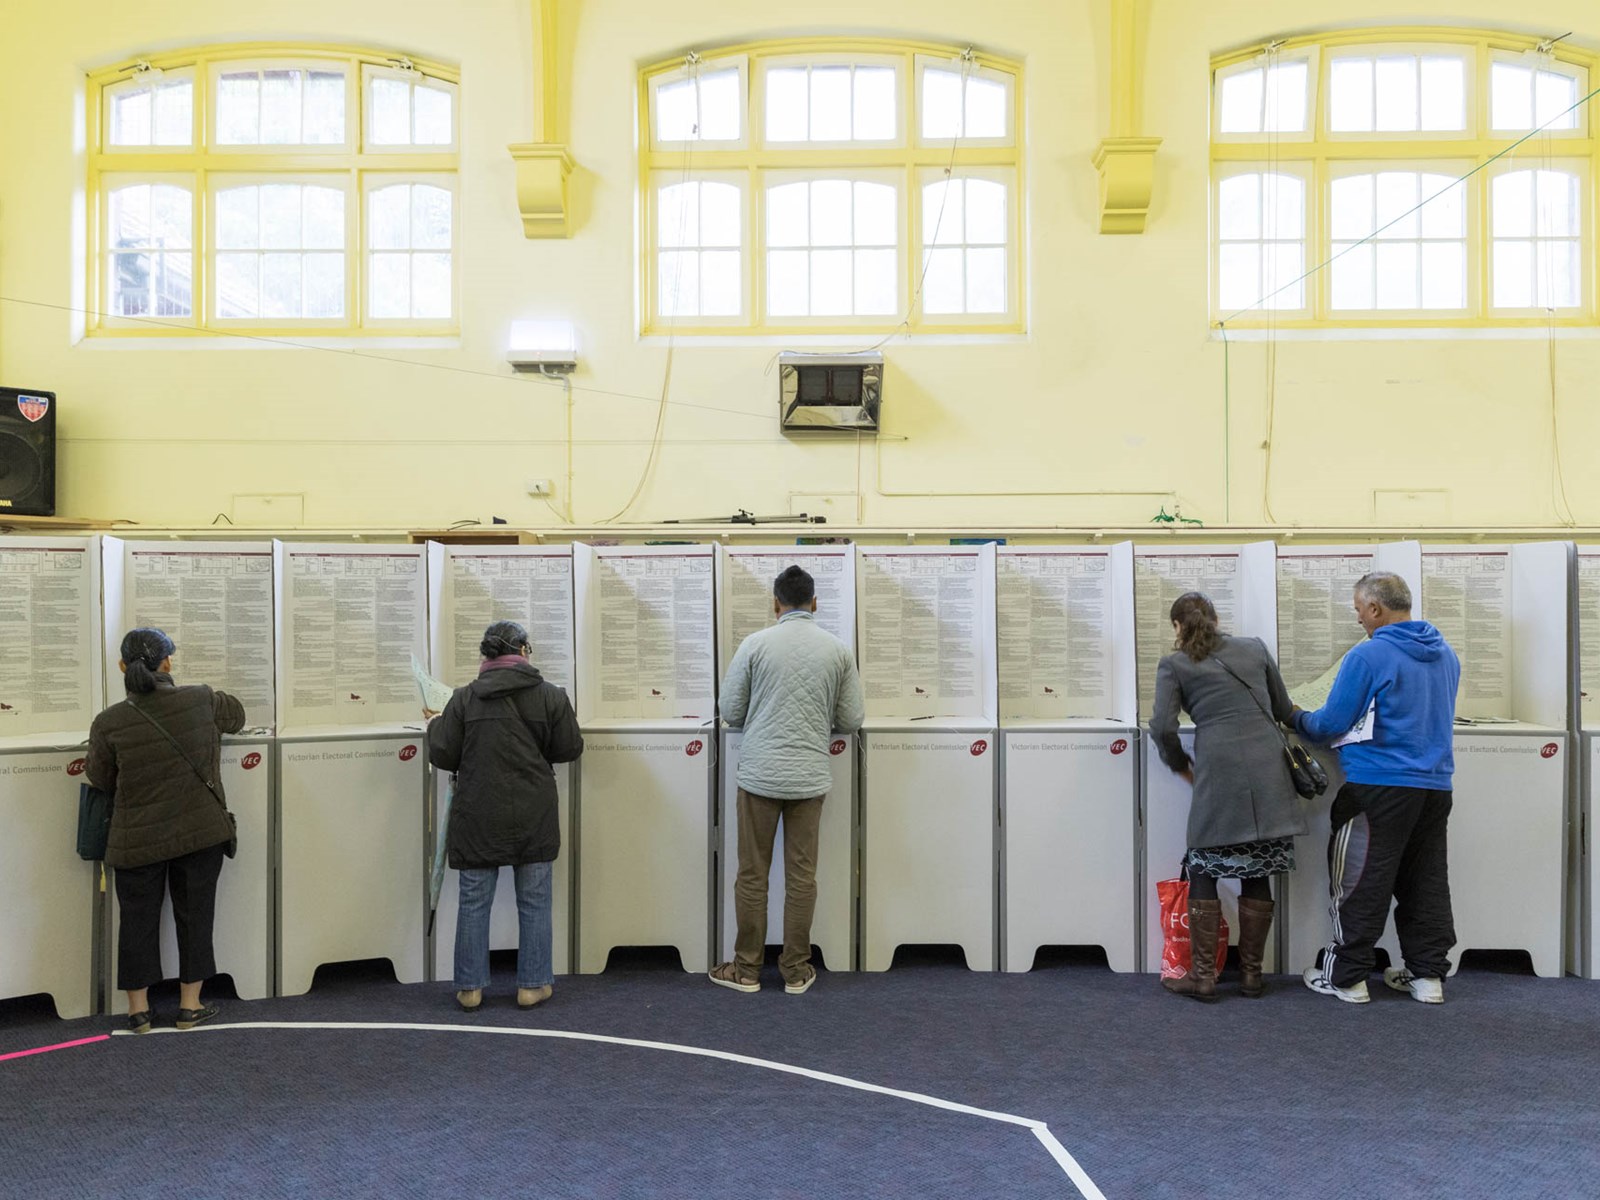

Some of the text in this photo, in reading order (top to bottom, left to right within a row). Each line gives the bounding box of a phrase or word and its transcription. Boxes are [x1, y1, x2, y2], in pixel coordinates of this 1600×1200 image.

[586, 743, 682, 752] Victorian Electoral Commission
[872, 743, 967, 751] Victorian Electoral Commission
[1011, 743, 1107, 751] Victorian Electoral Commission
[1469, 745, 1498, 753] Electoral
[1499, 746, 1538, 755] Commission
[287, 750, 395, 761] Victorian Electoral Commission
[12, 764, 63, 775] Commission
